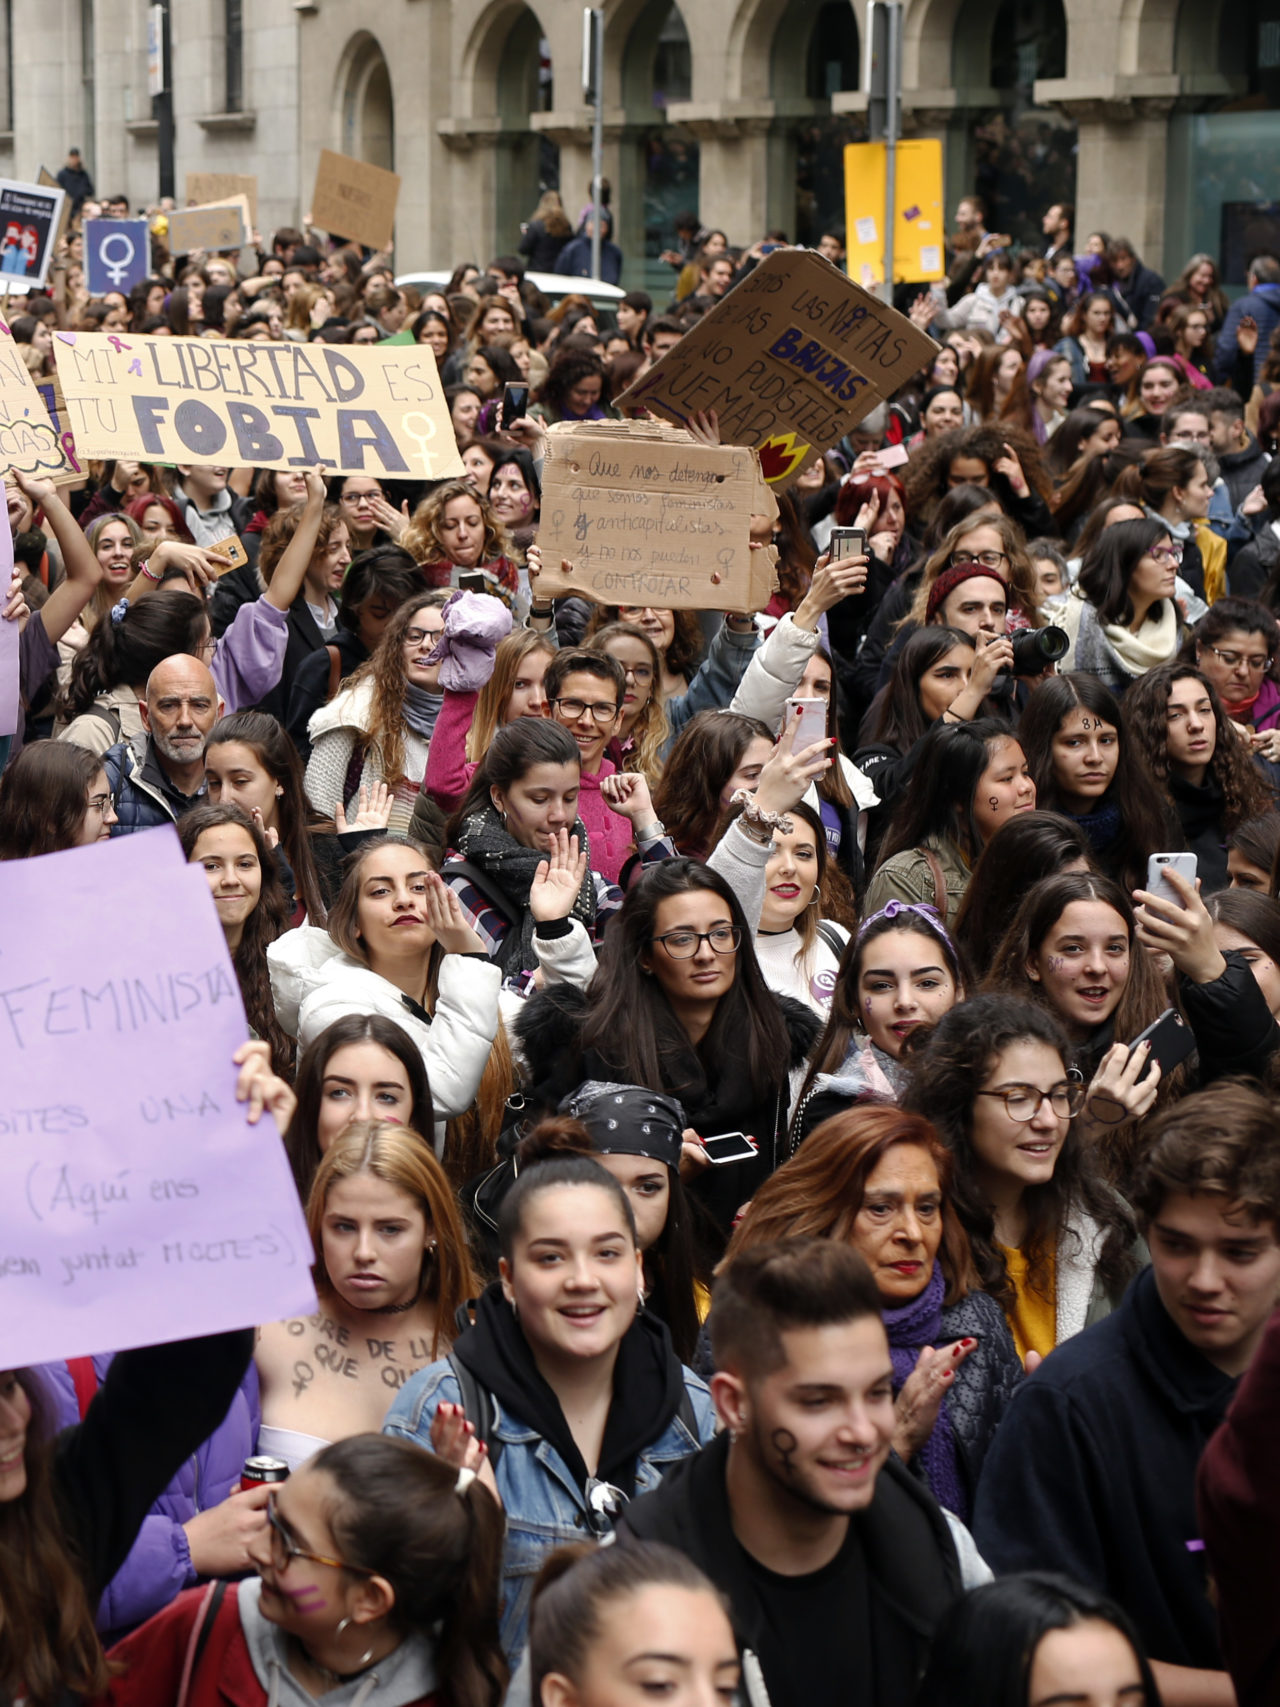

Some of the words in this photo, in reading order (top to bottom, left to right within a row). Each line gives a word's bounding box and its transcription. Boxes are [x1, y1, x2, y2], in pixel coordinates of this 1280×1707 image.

[791, 288, 829, 321] LAS
[703, 341, 733, 365] NO
[770, 328, 869, 402] BRUJAS
[72, 349, 117, 385] MI
[144, 342, 365, 403] LIBERTAD
[382, 364, 434, 402] ES
[66, 398, 118, 433] TU
[131, 395, 411, 472] FOBIA
[589, 451, 620, 477] Que
[571, 487, 600, 513] que
[608, 490, 650, 506] somos
[596, 513, 732, 539] anticapitalistas
[599, 546, 615, 561] no
[592, 573, 692, 597] CONTROLAR
[1082, 717, 1103, 731] 8M
[140, 1090, 222, 1124] UNA
[25, 1160, 132, 1226] (Aquí
[149, 1177, 200, 1203] ens
[60, 1248, 146, 1286] juntat
[365, 1338, 396, 1361] DE
[314, 1343, 360, 1379] QUE
[381, 1366, 420, 1390] QU
